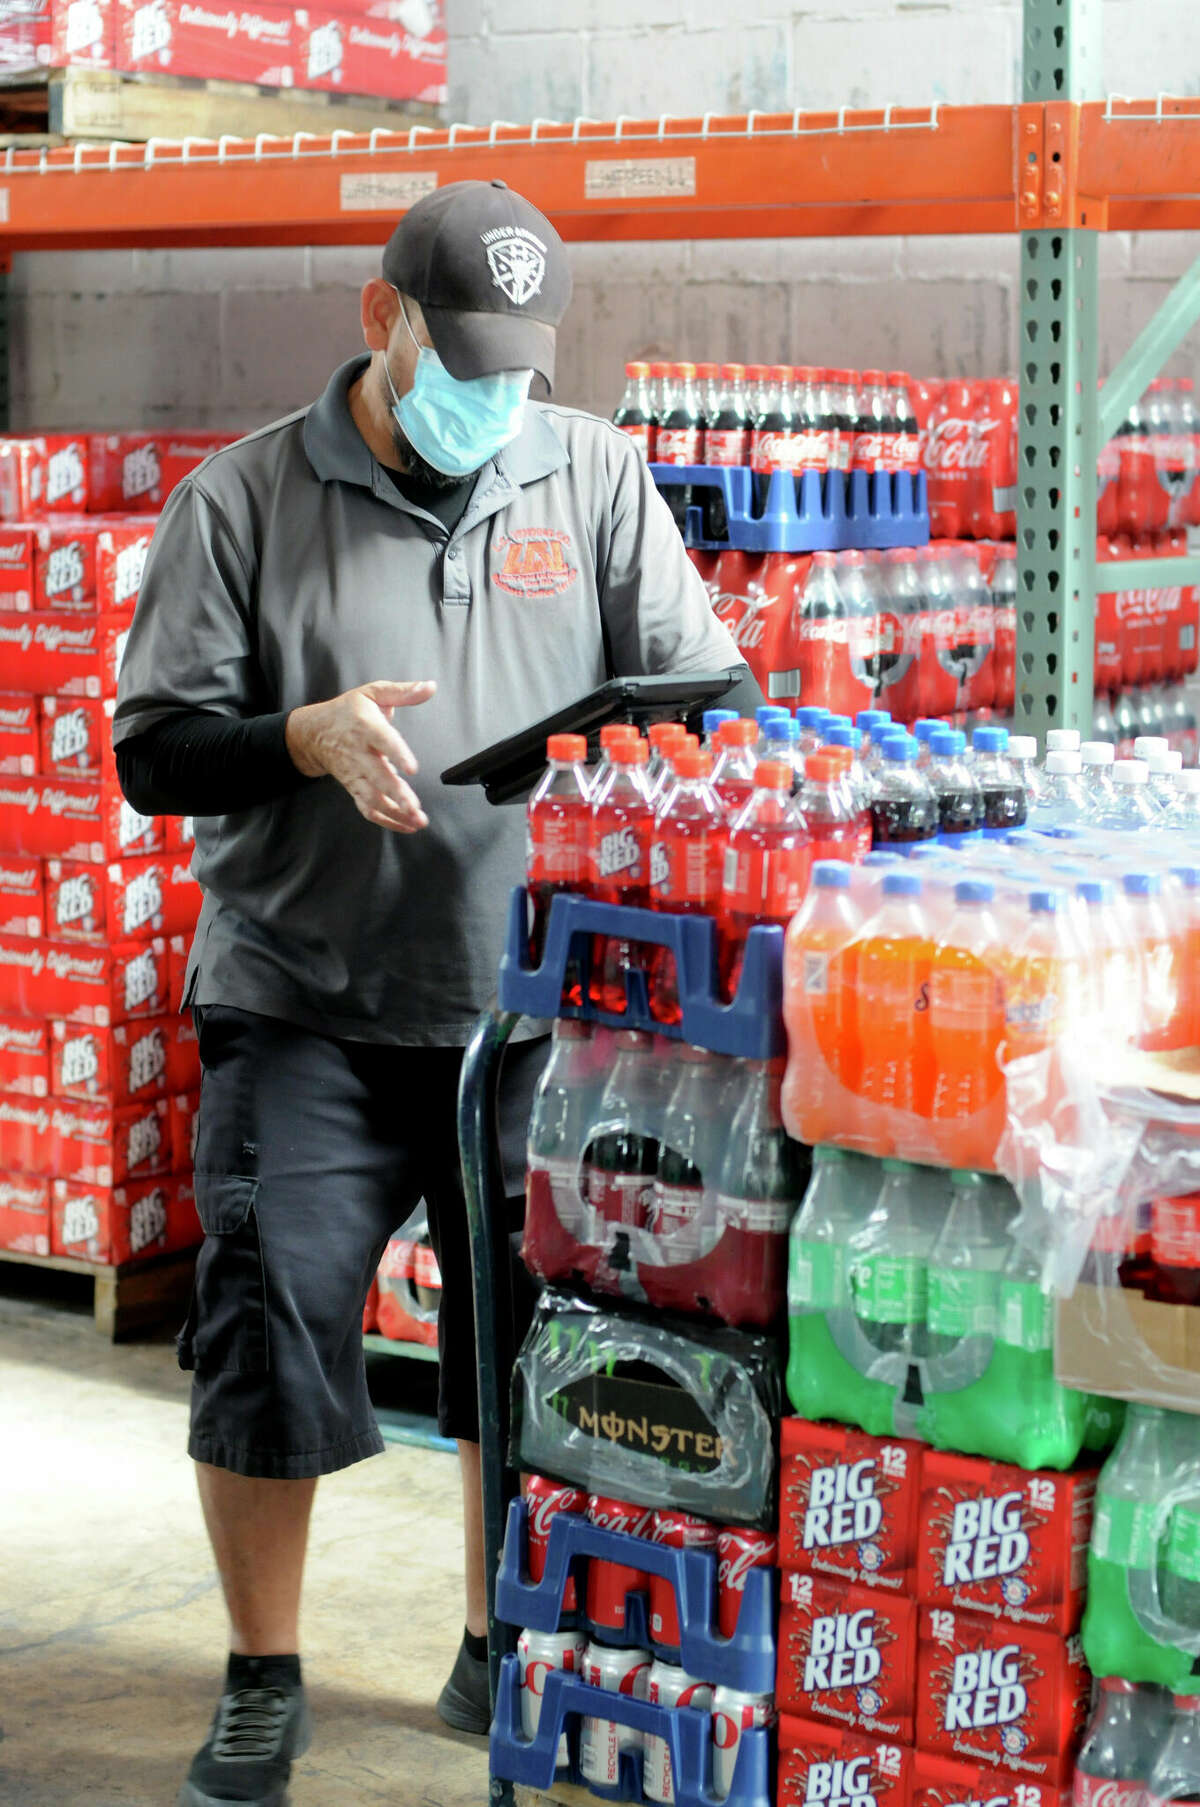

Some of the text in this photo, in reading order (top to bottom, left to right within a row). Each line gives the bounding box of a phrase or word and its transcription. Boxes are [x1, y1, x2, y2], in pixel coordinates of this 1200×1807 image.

[601, 843, 640, 877] RED
[880, 1445, 907, 1470] 12
[809, 1458, 876, 1509] BIG
[1027, 1477, 1056, 1503] 12
[802, 1497, 882, 1550] RED
[951, 1491, 1023, 1544] BIG
[943, 1530, 1030, 1586] RED
[789, 1573, 814, 1597] 12
[811, 1608, 875, 1657] BIG
[929, 1608, 955, 1634] 12
[803, 1646, 881, 1692] RED
[952, 1644, 1021, 1694] BIG
[811, 1700, 900, 1734] Deliciously Different!
[944, 1683, 1027, 1731] RED
[607, 1736, 617, 1780] RECYCLE
[806, 1756, 871, 1801] BIG
[876, 1744, 902, 1769] 12
[1014, 1784, 1041, 1807] 12
